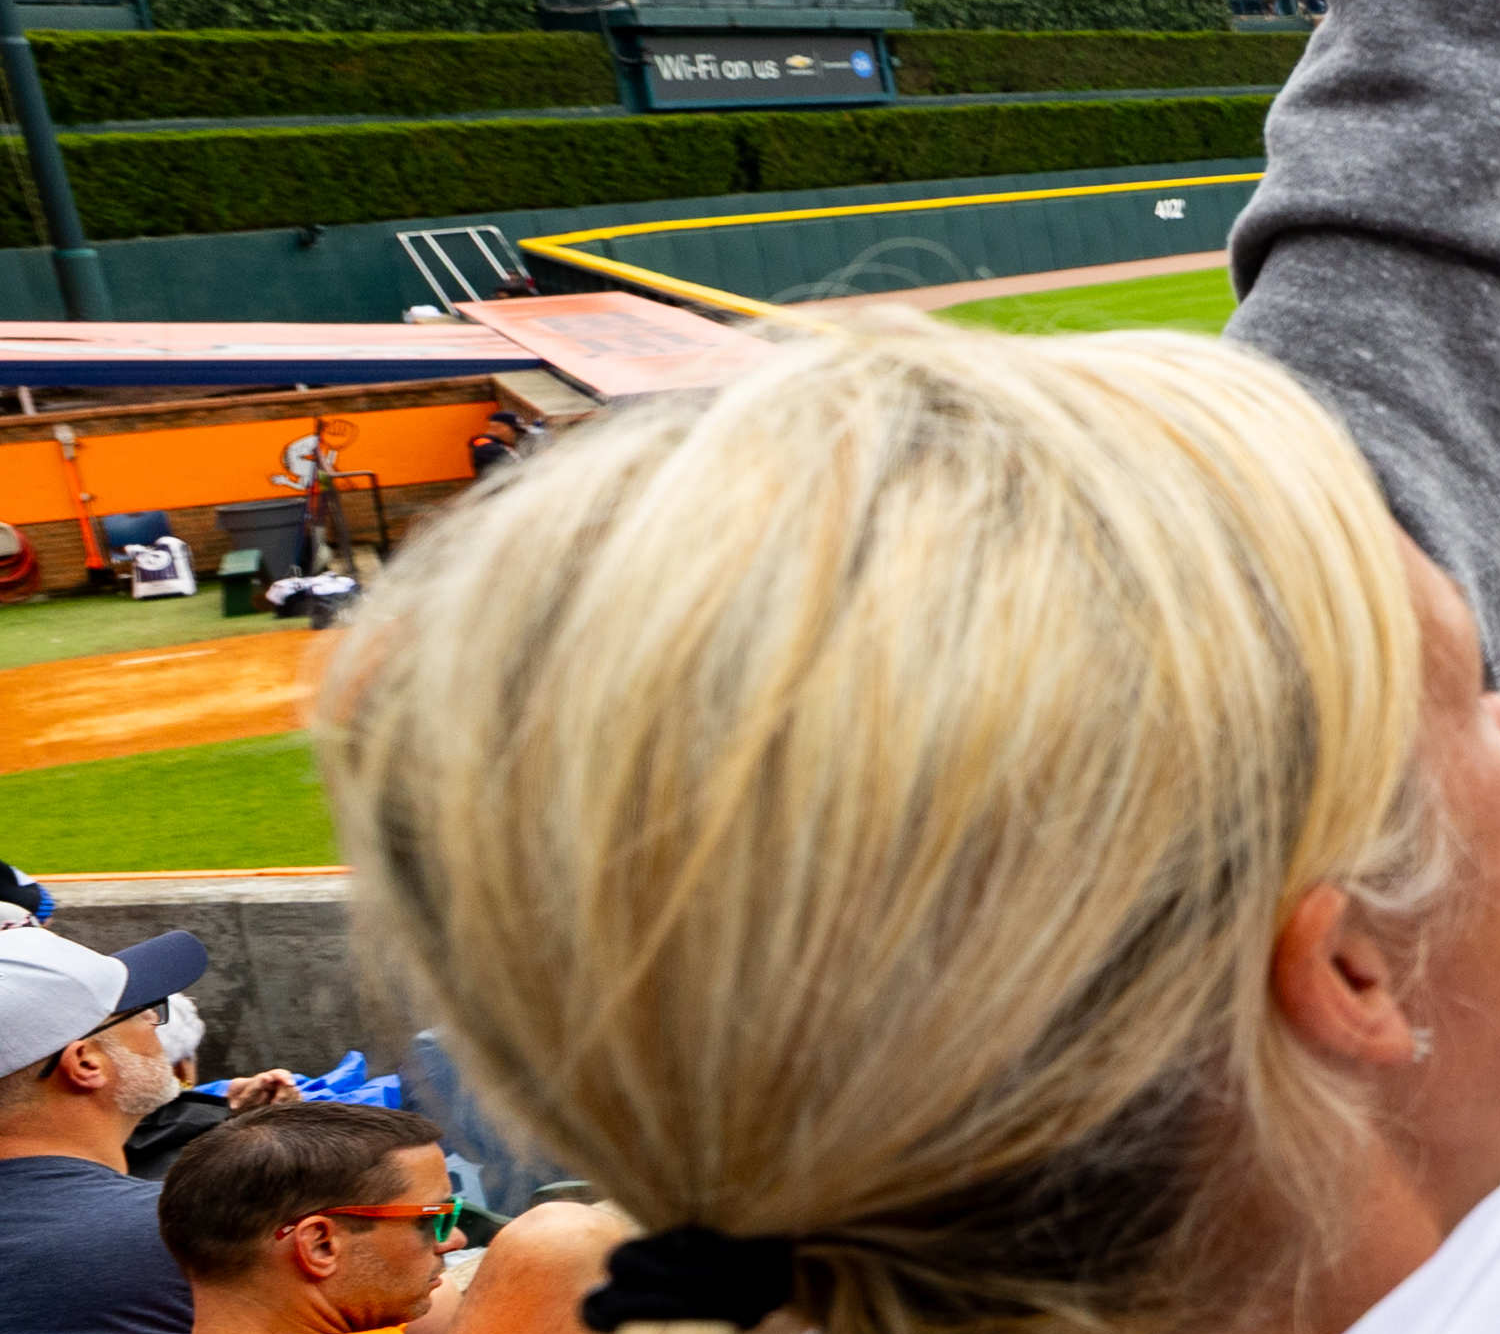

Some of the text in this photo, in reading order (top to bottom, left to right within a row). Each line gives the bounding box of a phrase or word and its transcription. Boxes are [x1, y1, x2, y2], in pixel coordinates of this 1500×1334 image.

[654, 54, 781, 82] Wi-Fi on us
